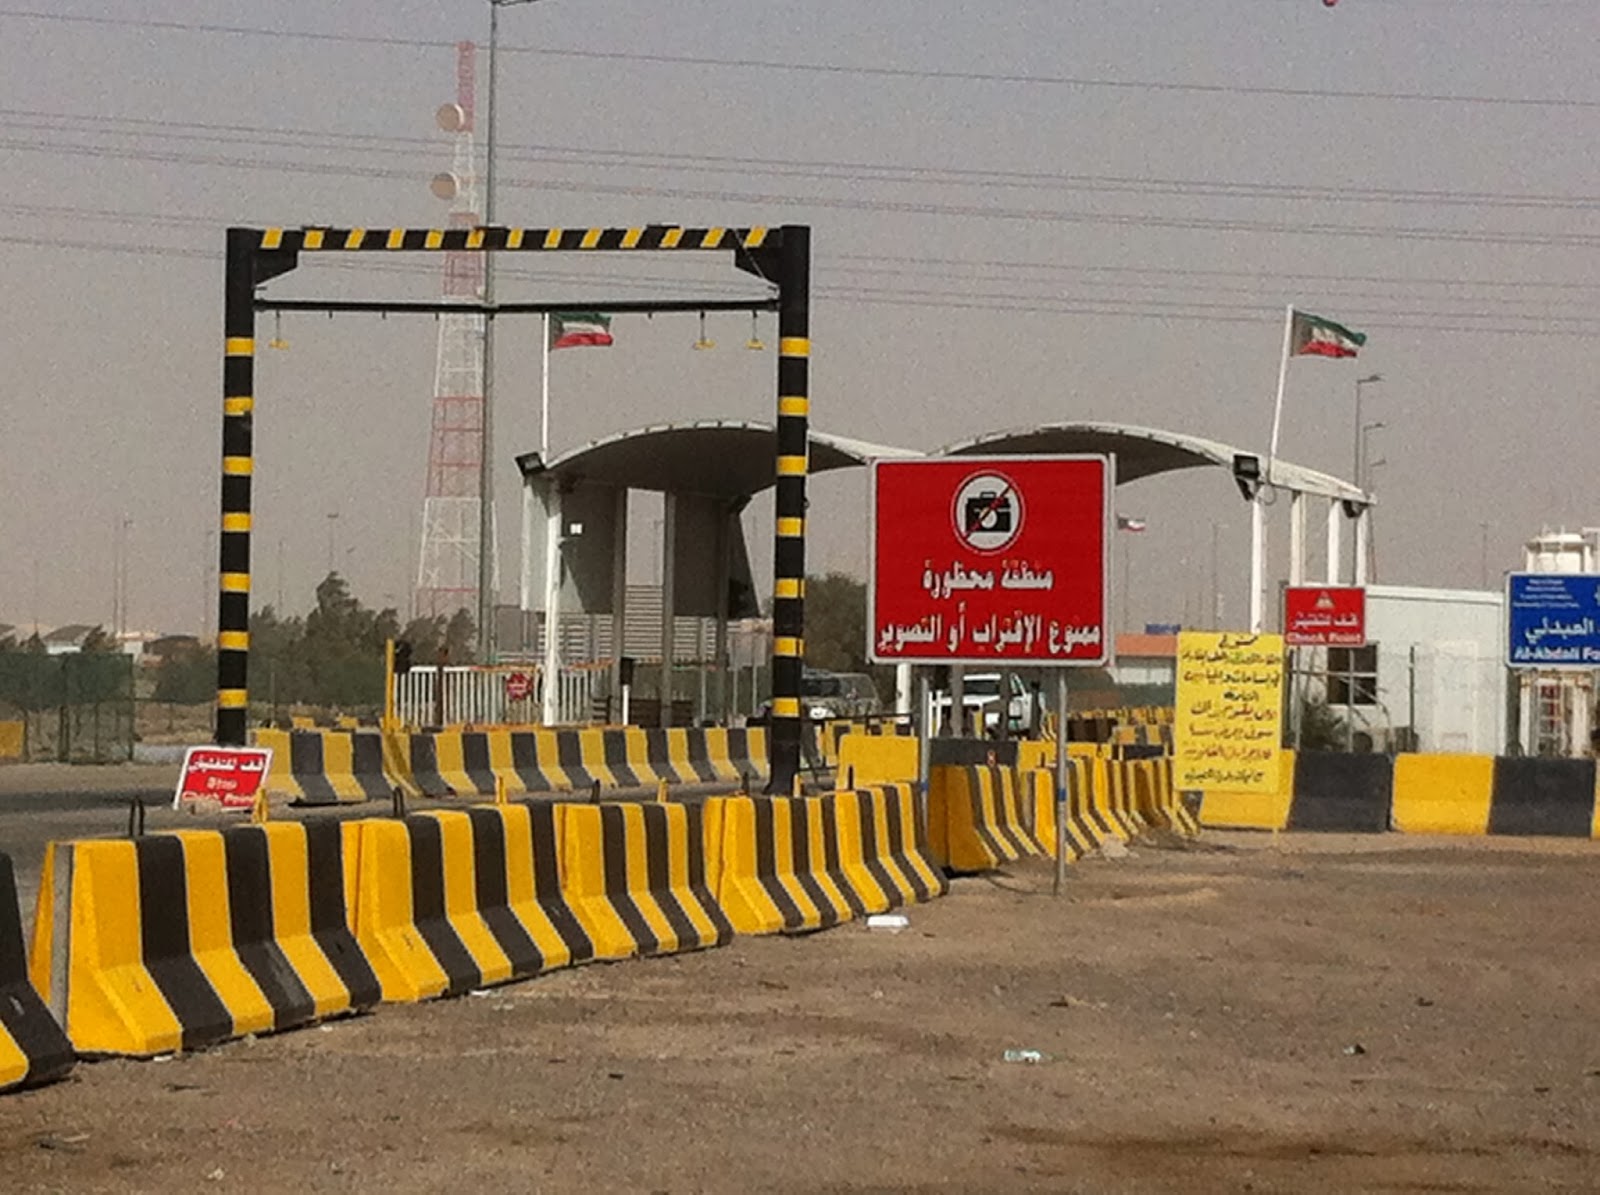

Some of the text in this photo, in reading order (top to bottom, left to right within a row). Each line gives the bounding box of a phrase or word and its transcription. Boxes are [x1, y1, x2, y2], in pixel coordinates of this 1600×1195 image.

[922, 560, 1054, 600] منطقة محظورة
[877, 613, 942, 653] التصوير
[947, 600, 967, 653] أو
[1048, 615, 1101, 655] ممنوع
